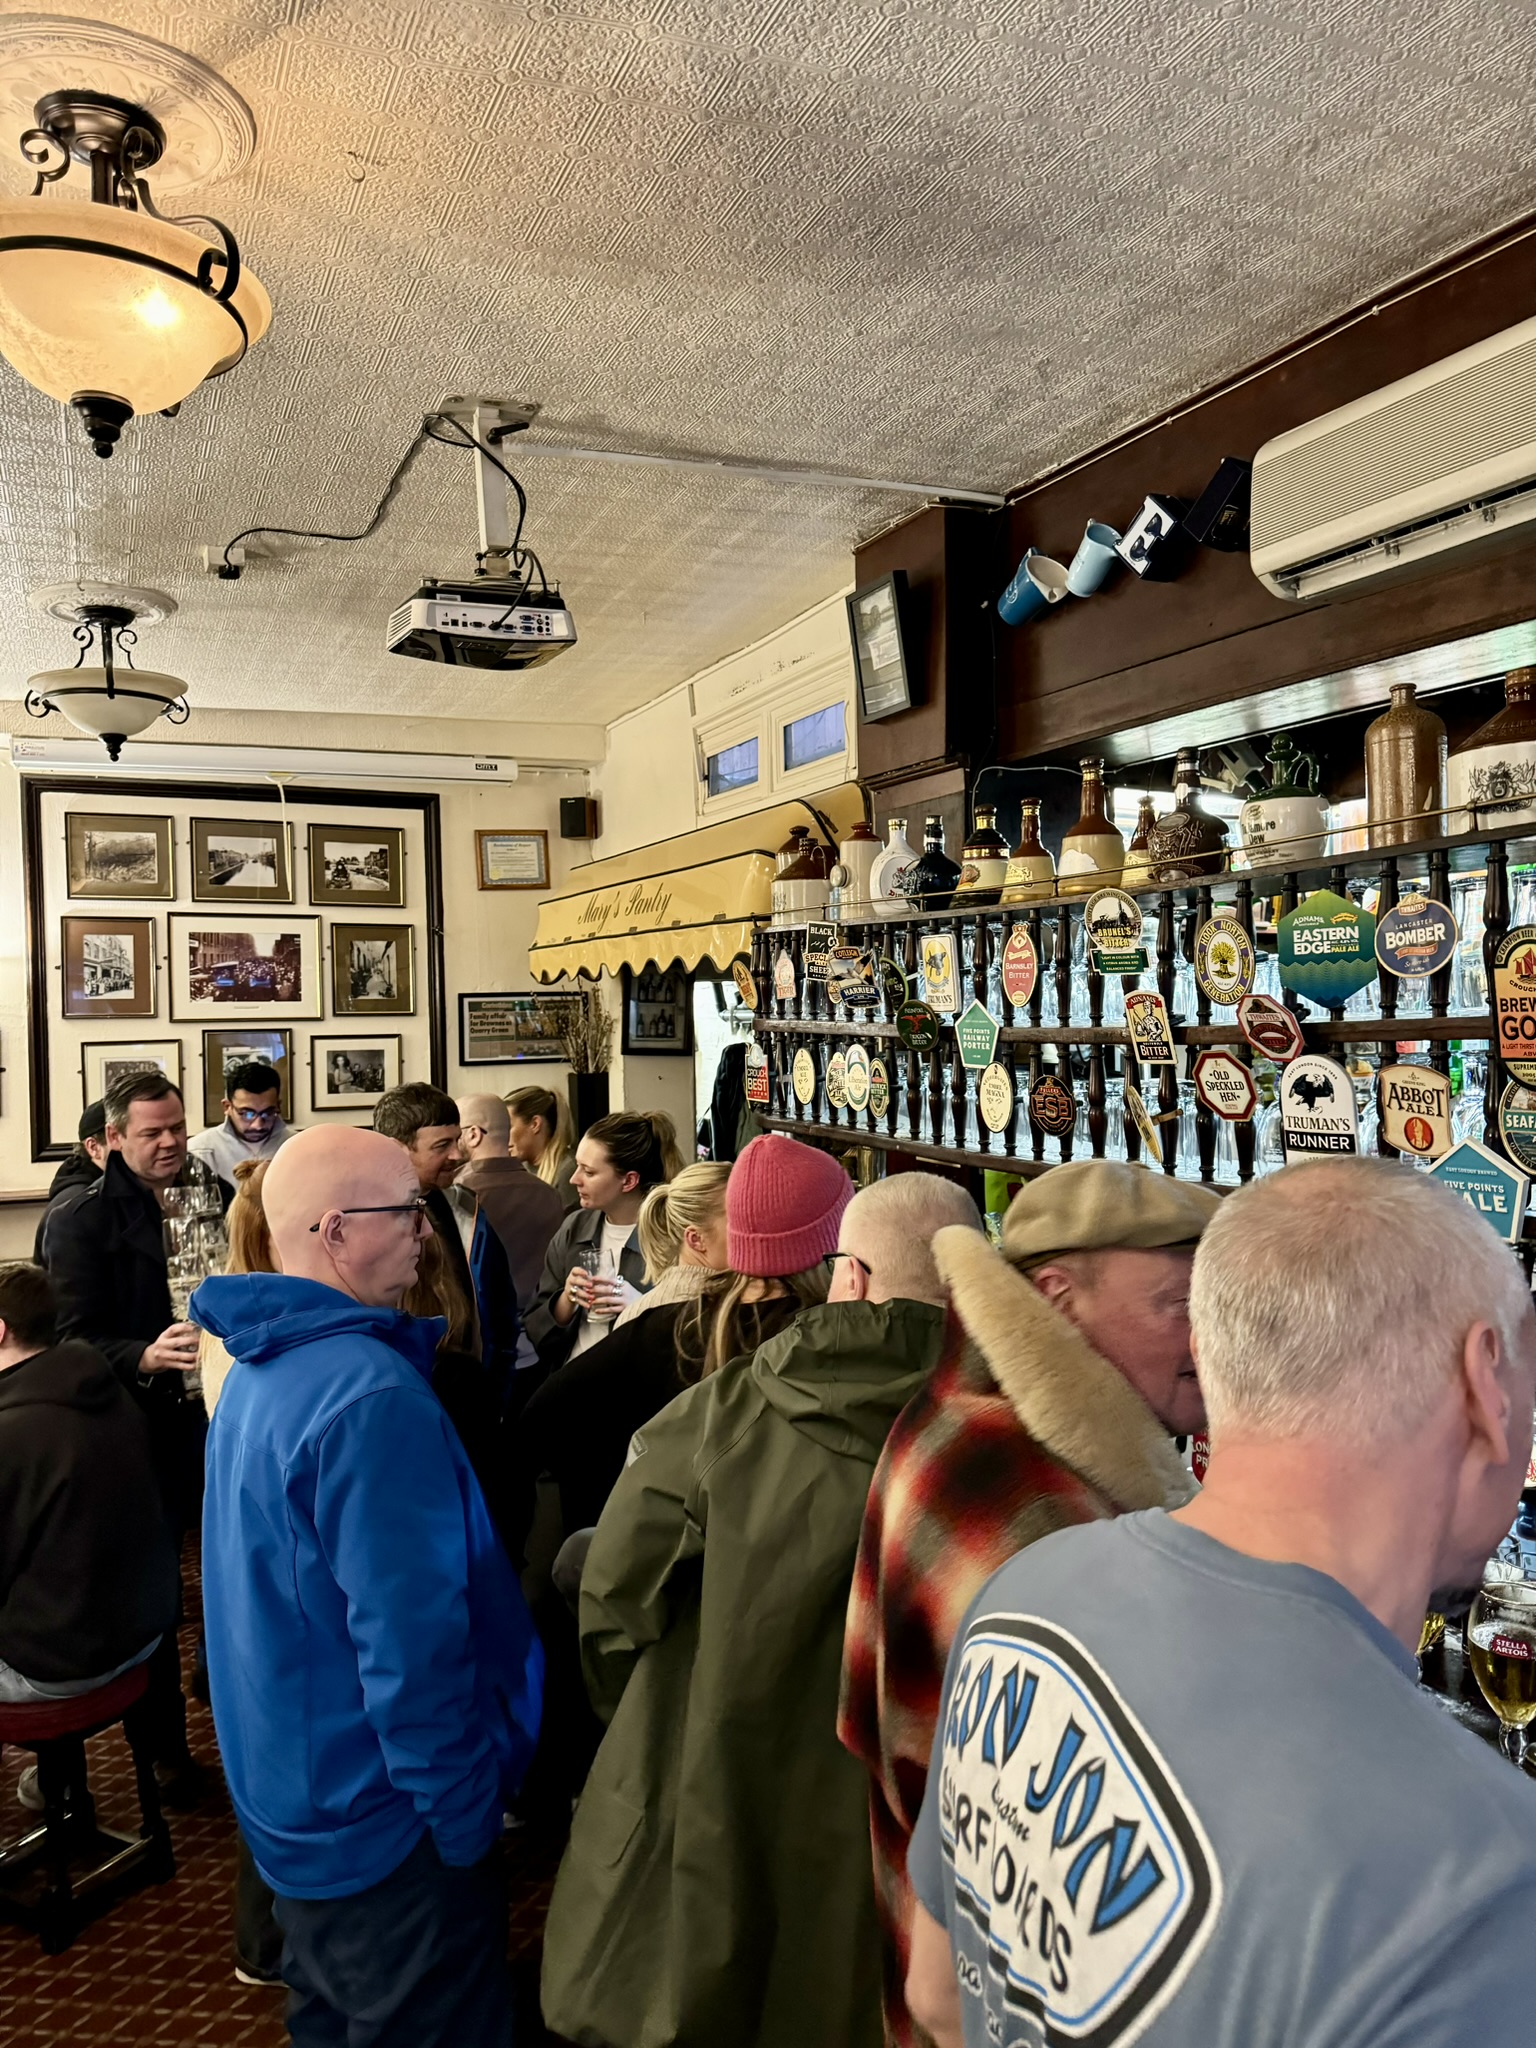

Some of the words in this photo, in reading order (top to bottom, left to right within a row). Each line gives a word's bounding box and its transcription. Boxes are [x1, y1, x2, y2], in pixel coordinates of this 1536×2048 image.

[577, 890, 621, 934] Mary's
[624, 882, 672, 926] Pantry
[1292, 915, 1325, 927] ADNAMS
[1395, 918, 1433, 930] LANCASTER
[810, 926, 833, 936] BLACK
[1098, 927, 1132, 937] BRUNEL'S
[1200, 923, 1218, 946] HOOK
[1220, 920, 1247, 950] NORTON
[1293, 925, 1359, 943] EASTERN
[1385, 922, 1446, 949] BOMBER
[1103, 938, 1130, 947] BITTER
[1294, 941, 1331, 955] EDGE
[1500, 931, 1521, 956] CHAMPION
[1520, 929, 1534, 939] BEER
[805, 953, 827, 962] SPECI
[809, 965, 828, 974] SHEE
[1005, 962, 1034, 970] BARNSLEY
[1008, 971, 1030, 979] BITTER
[778, 986, 794, 997] TIGER
[843, 986, 876, 996] HARRIER
[1203, 979, 1245, 1003] GENERATION
[1129, 995, 1157, 1005] ADNAMS
[963, 1034, 991, 1042] RAILWAY
[963, 1041, 991, 1050] PORTER
[1140, 1044, 1169, 1056] BITTER
[1296, 1062, 1314, 1070] LONDON
[747, 1068, 767, 1078] CROUCH
[1212, 1069, 1230, 1081] OLD
[747, 1077, 767, 1091] BEST
[1205, 1080, 1245, 1091] SPECKLED
[1219, 1092, 1238, 1102] HEN
[1386, 1082, 1445, 1118] ABBOT
[1035, 1096, 1069, 1119] ESB
[1406, 1103, 1435, 1117] ALE
[1285, 1115, 1351, 1131] TRUMAN'S
[1289, 1133, 1350, 1150] RUNNER
[1510, 1141, 1535, 1168] QUALITY
[1443, 1180, 1466, 1190] FIVE
[1467, 1182, 1505, 1194] POINTS
[1496, 1639, 1527, 1650] STELLA
[1495, 1645, 1528, 1657] ARTOIS
[1024, 1711, 1165, 1936] JON
